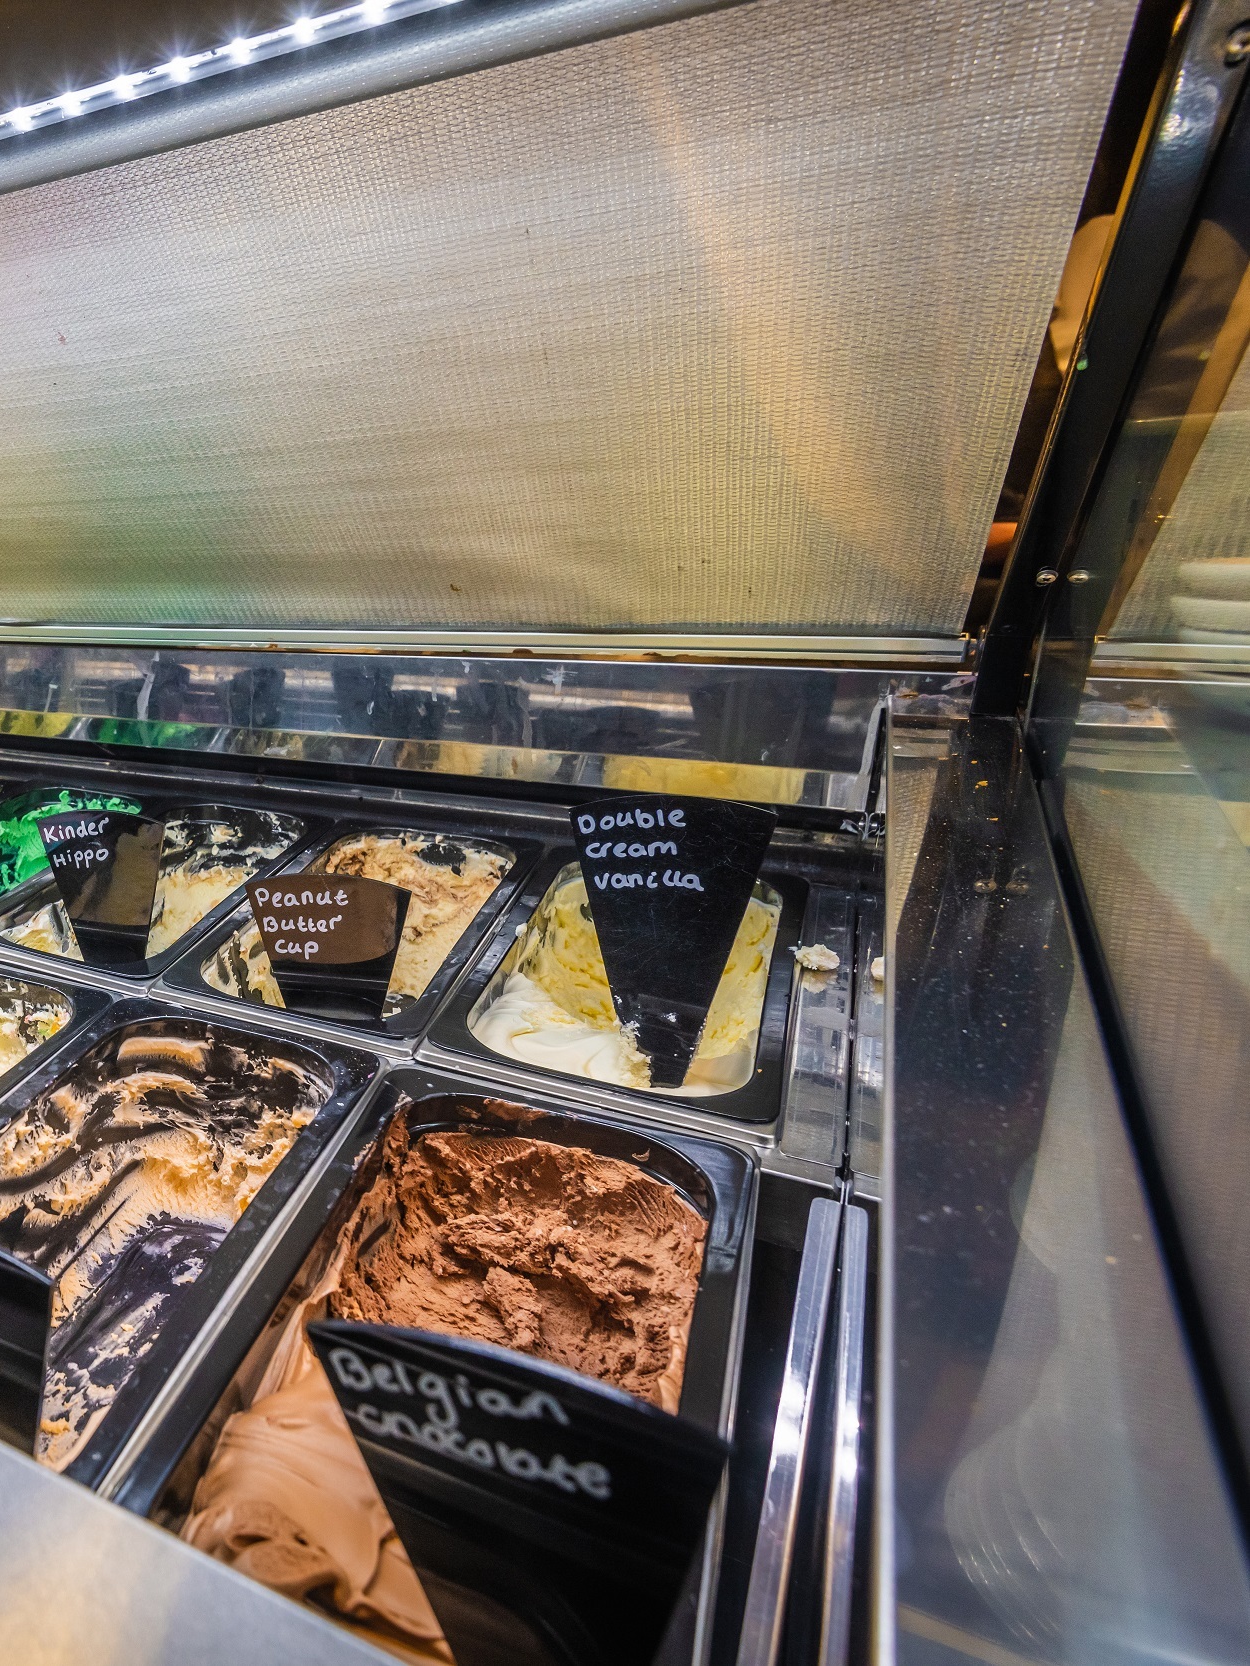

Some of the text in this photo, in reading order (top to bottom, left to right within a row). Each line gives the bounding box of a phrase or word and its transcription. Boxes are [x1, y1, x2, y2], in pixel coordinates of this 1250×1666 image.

[43, 817, 110, 843] Kinder
[577, 808, 686, 834] Double
[52, 848, 109, 869] Hippo
[254, 887, 349, 908] Peanut
[262, 914, 343, 933] Butter
[327, 1346, 571, 1427] Belgian
